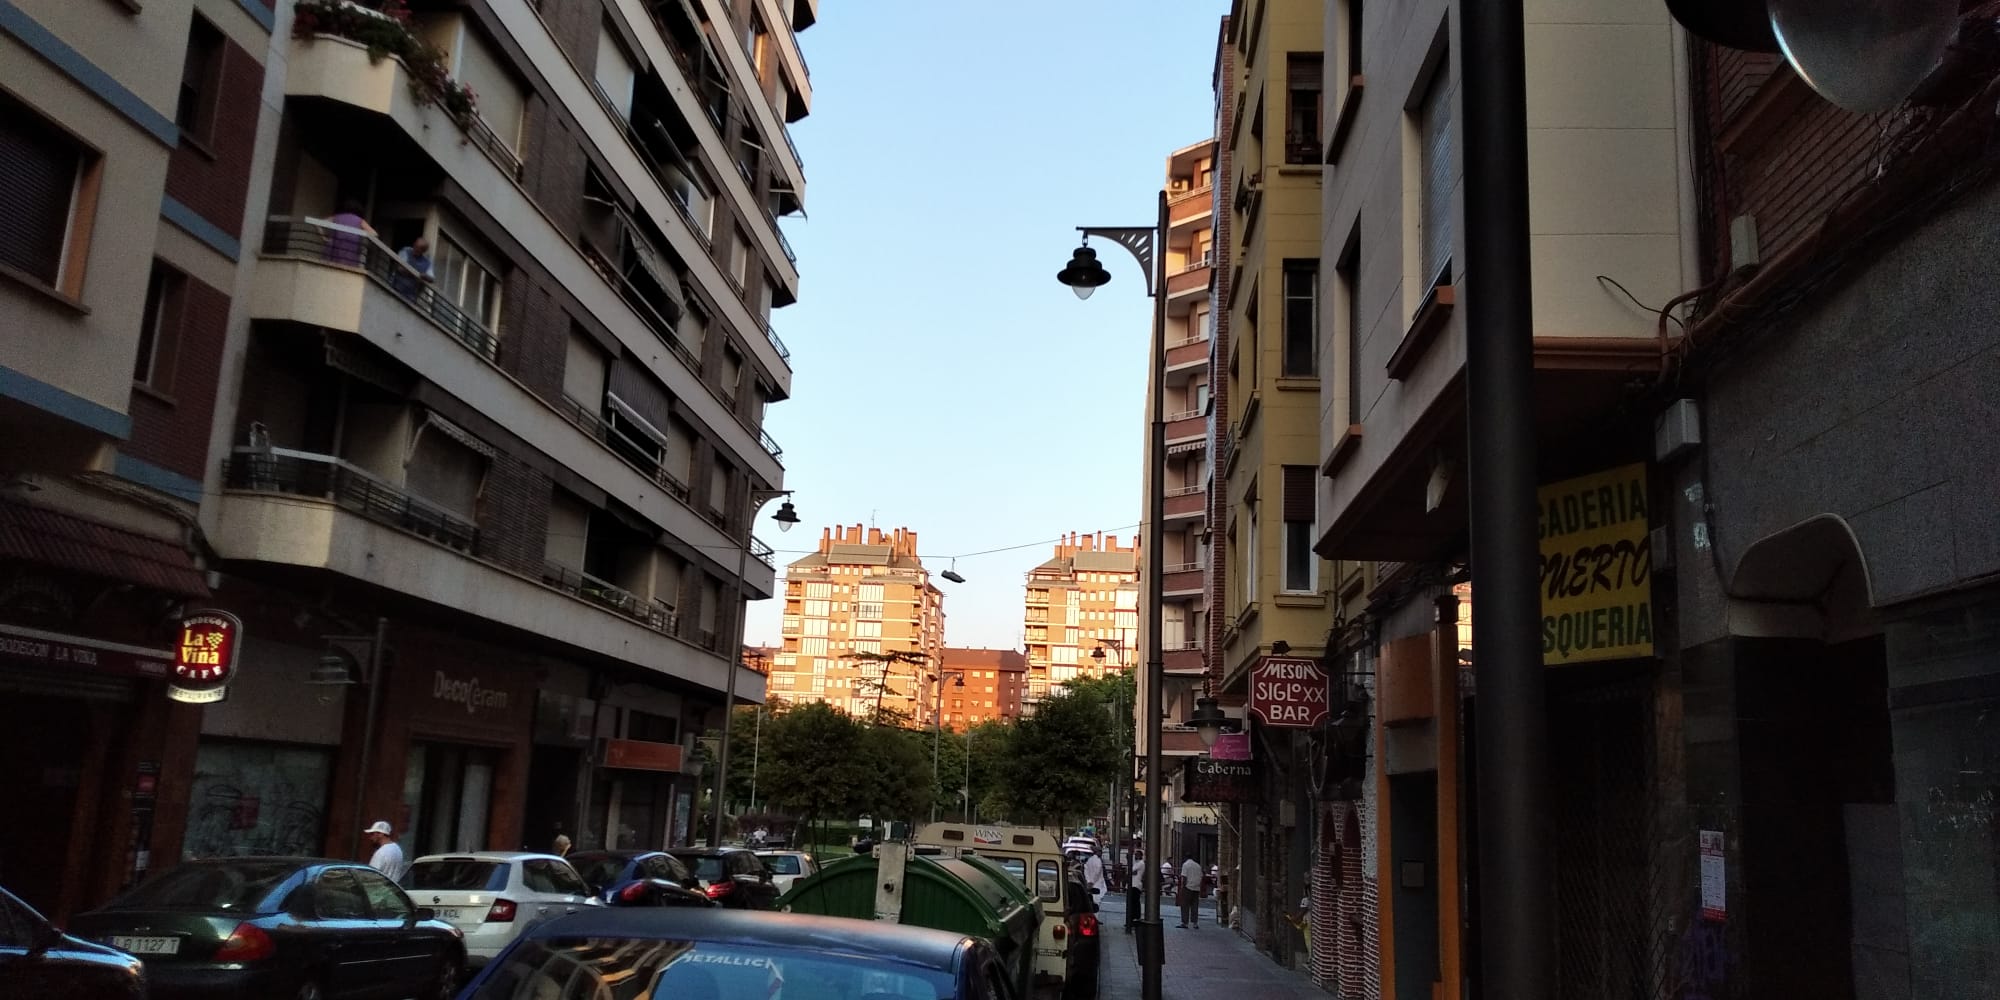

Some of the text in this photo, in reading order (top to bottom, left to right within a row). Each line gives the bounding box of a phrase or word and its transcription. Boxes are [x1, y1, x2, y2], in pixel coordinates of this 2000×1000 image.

[183, 629, 204, 646] La
[181, 646, 220, 664] Viña
[1303, 686, 1325, 703] XX
[1270, 704, 1310, 721] BAR
